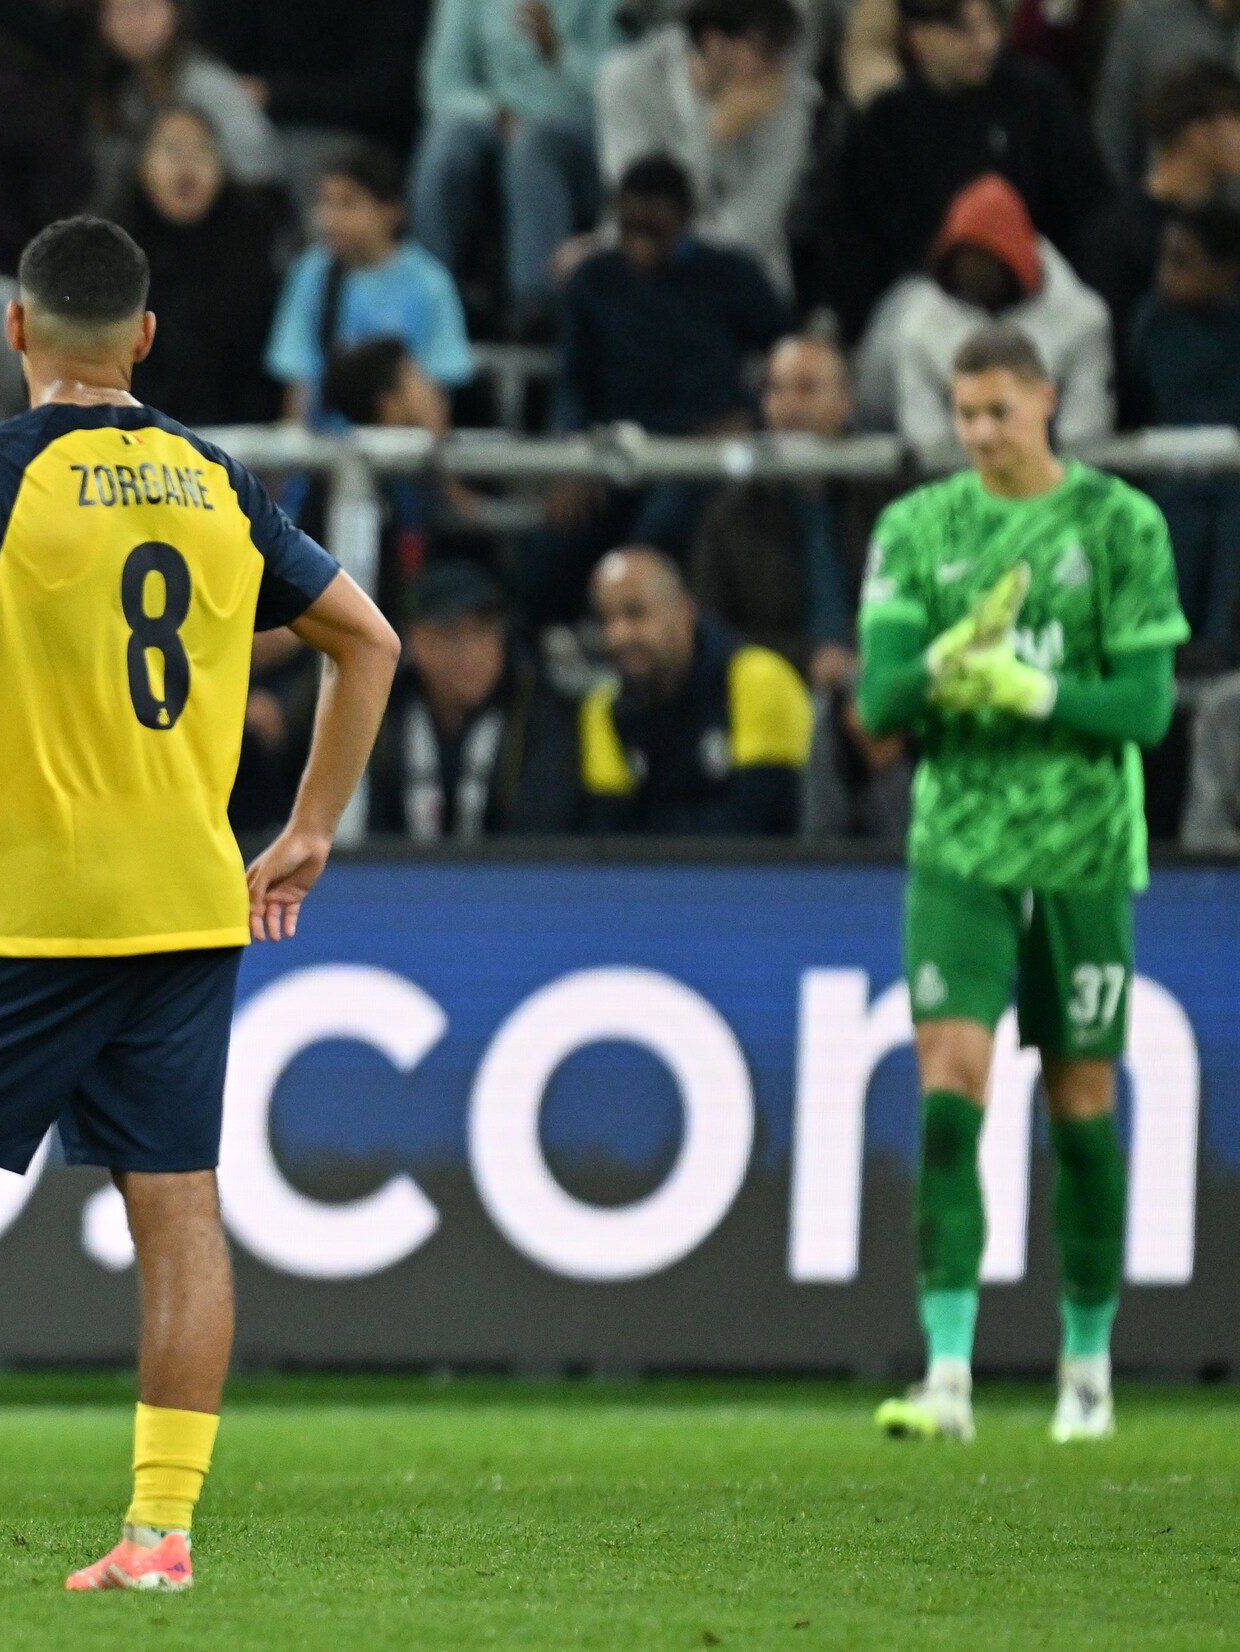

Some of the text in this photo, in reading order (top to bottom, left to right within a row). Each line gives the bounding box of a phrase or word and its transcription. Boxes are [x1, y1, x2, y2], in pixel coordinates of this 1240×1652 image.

[70, 462, 214, 510] ZORGANE
[121, 540, 192, 730] 8
[1067, 962, 1126, 1028] 37
